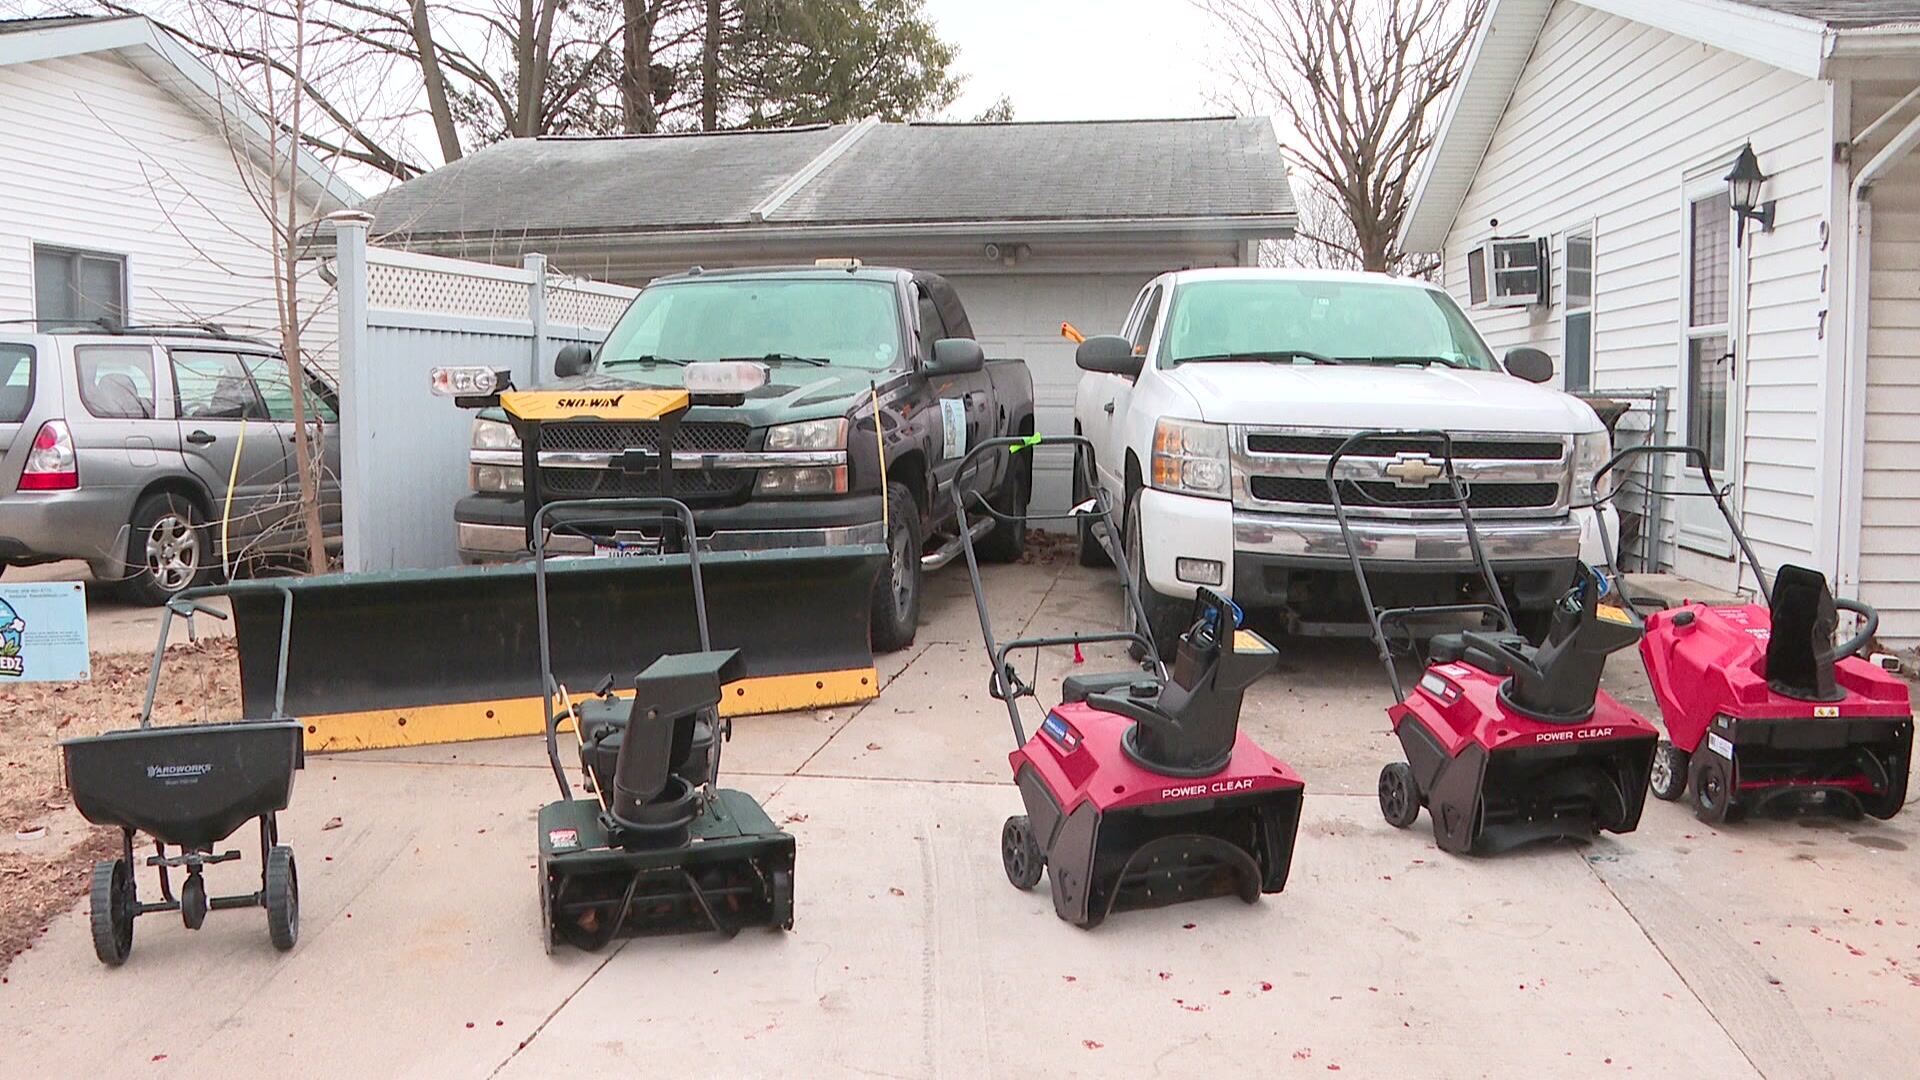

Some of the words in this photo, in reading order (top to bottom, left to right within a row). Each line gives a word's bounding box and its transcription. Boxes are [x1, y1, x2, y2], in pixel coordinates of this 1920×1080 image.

[556, 394, 624, 408] SNO-WAY
[1536, 731, 1574, 742] POWER
[1577, 727, 1612, 738] CLEAR
[146, 763, 213, 778] YARDWORKS
[1162, 785, 1207, 799] POWER
[1211, 779, 1253, 792] CLEAR
